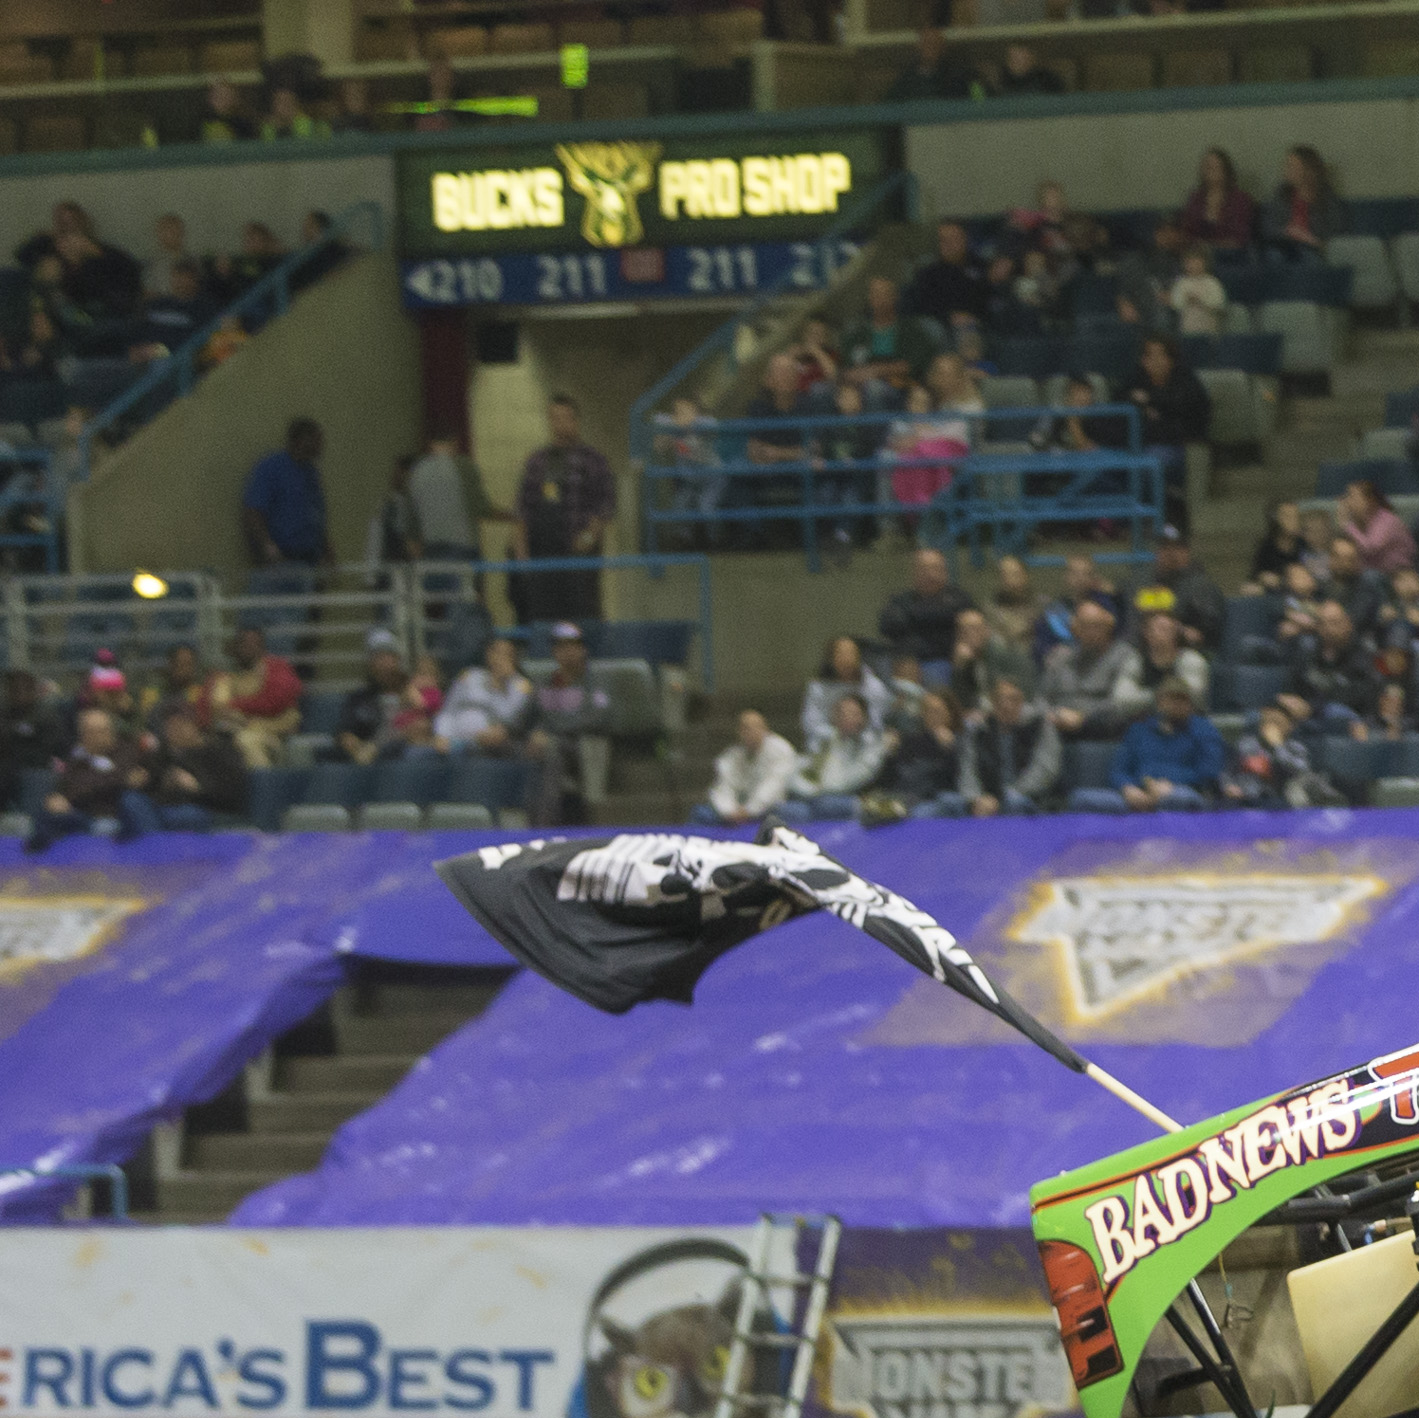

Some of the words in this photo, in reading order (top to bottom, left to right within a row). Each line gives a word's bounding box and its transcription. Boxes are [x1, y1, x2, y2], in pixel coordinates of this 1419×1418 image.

[430, 166, 565, 233] BUCKS
[659, 157, 741, 221] PRO
[742, 152, 852, 218] SHOP
[431, 258, 504, 303] 210
[536, 254, 607, 298] 211
[687, 247, 758, 292] 211
[1084, 1157, 1212, 1285] BAD
[1198, 1080, 1362, 1206] NEWS
[0, 1336, 287, 1411] RICA'S
